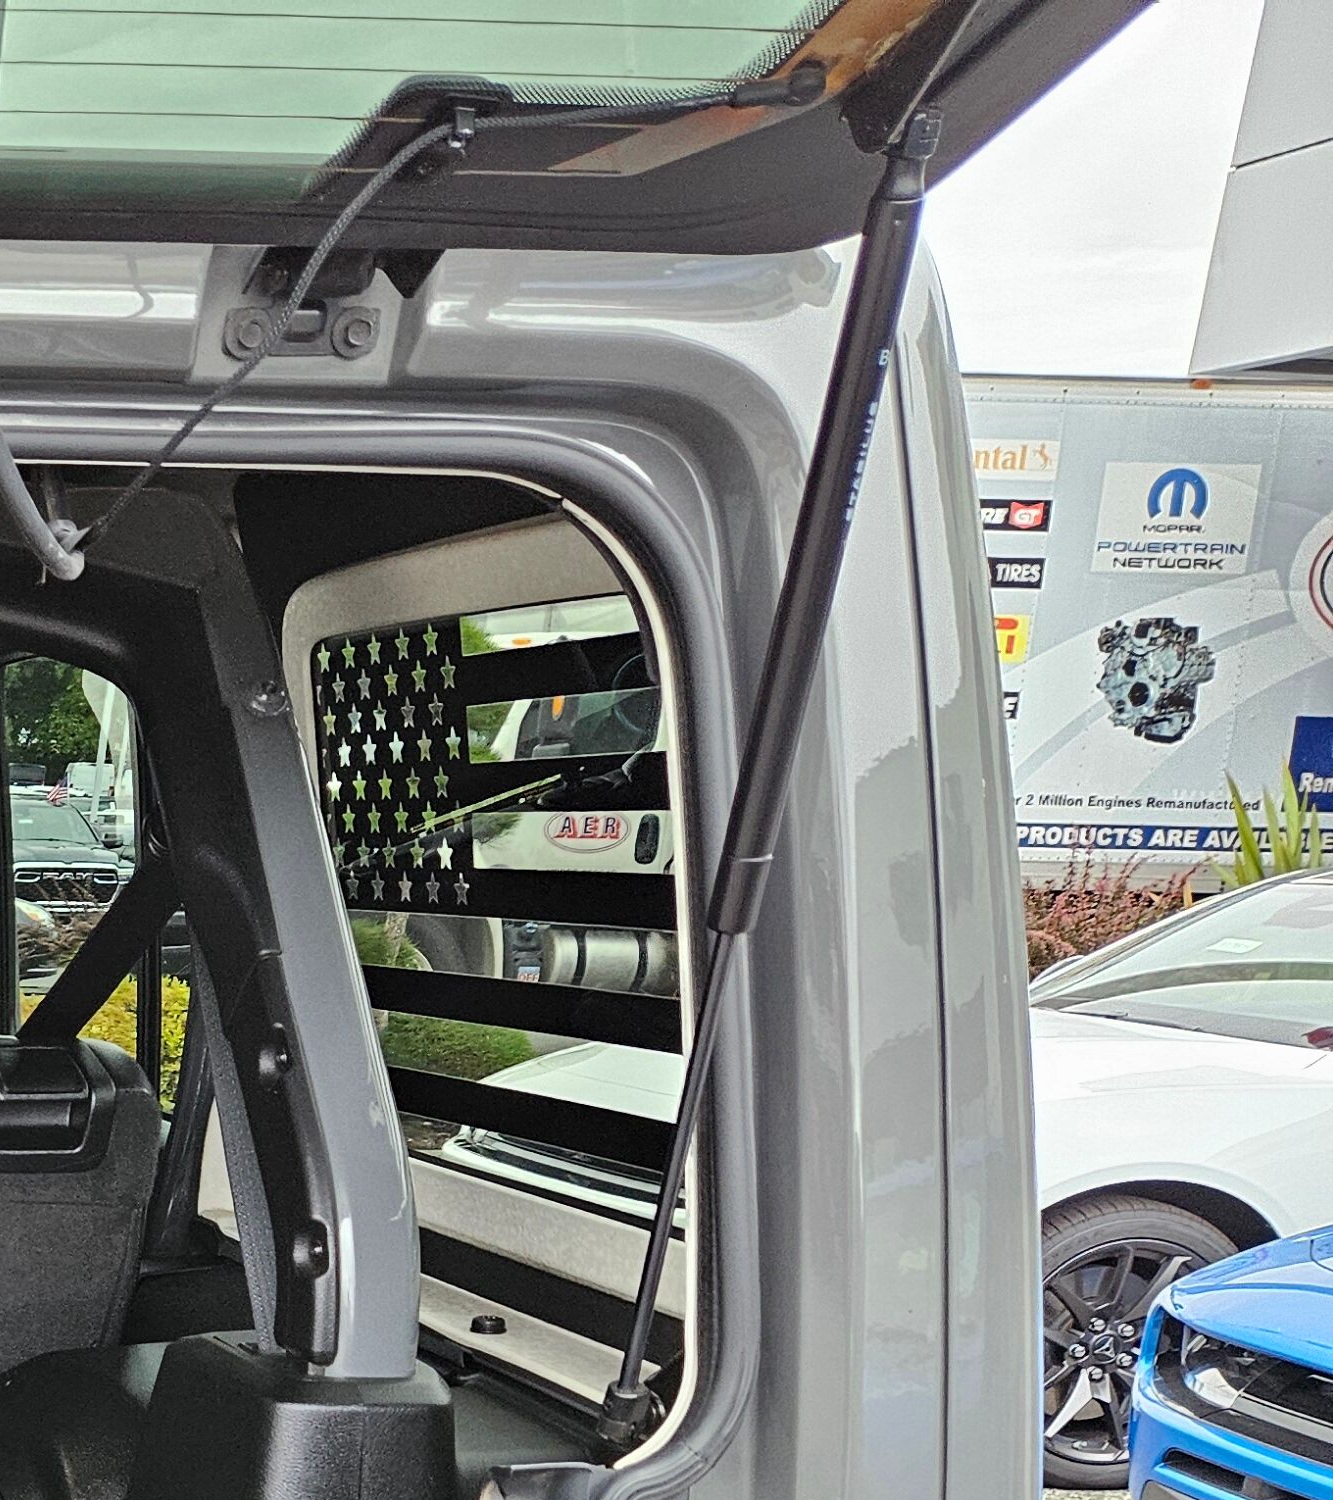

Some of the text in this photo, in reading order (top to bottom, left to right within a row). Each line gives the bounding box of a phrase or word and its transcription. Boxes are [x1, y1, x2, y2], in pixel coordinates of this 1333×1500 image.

[1097, 541, 1247, 555] POWERTRAIN
[1112, 557, 1225, 570] NETWORK
[995, 563, 1042, 584] TIRES
[1025, 794, 1034, 806] 2
[1038, 794, 1083, 807] Million
[1088, 795, 1141, 810] Engines
[1146, 797, 1261, 811] Remanufacted
[555, 815, 619, 838] AER
[1017, 826, 1144, 847] PRODUCTS
[1148, 828, 1200, 848] ARE
